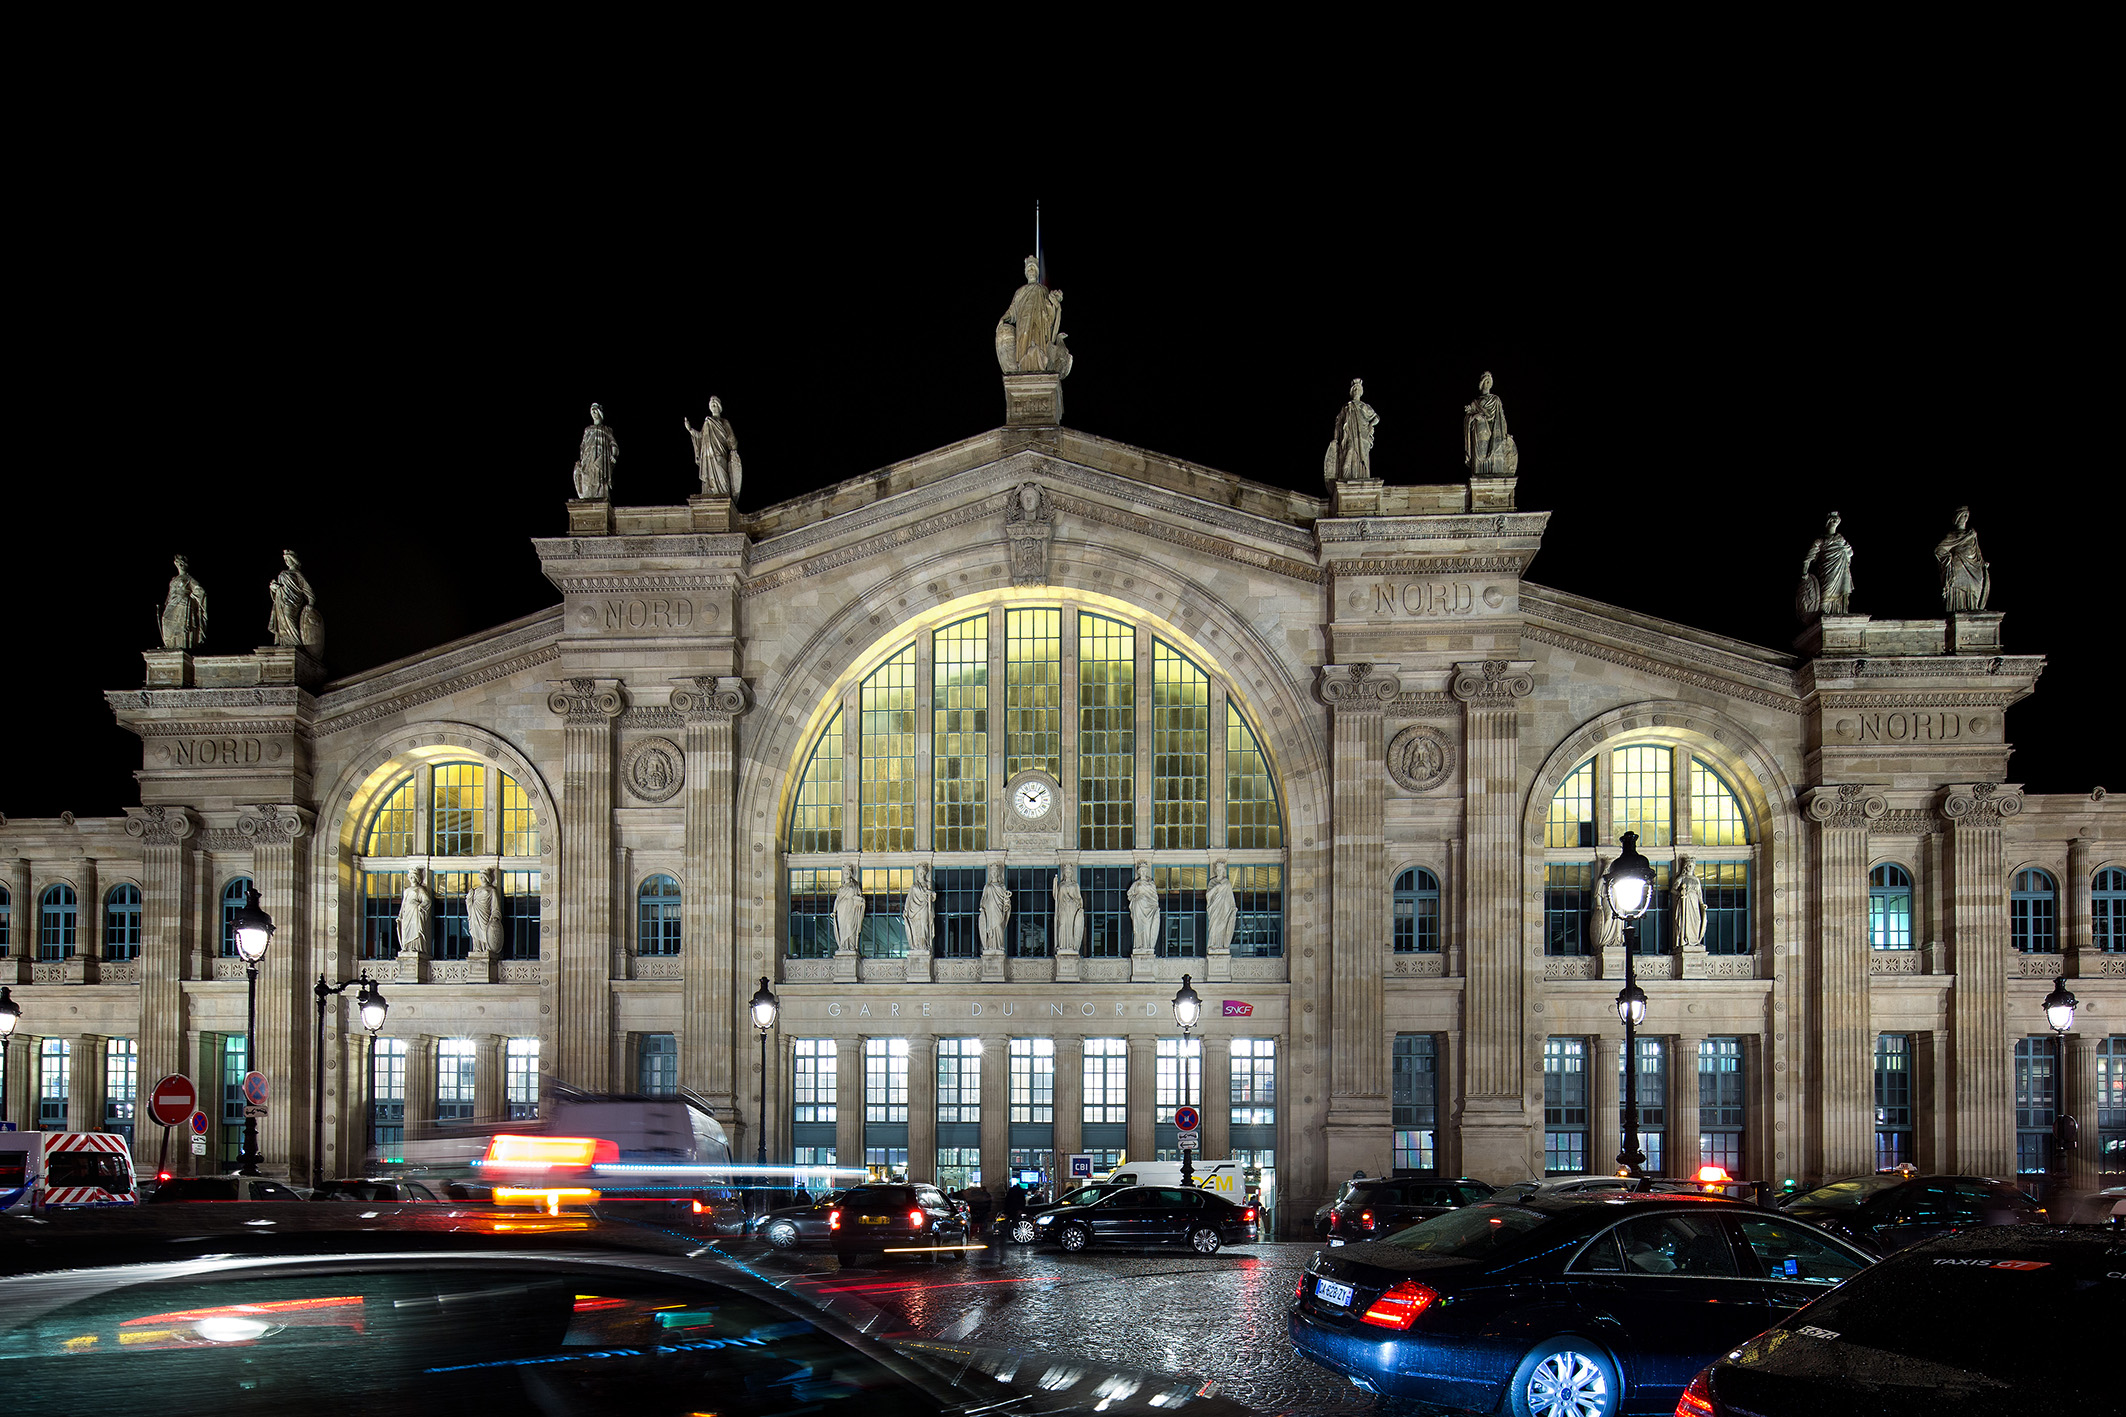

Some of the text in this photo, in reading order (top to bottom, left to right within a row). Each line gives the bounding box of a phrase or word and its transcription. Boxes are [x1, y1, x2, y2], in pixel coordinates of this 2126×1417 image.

[1374, 582, 1473, 615] NORD
[603, 598, 693, 630] NORD
[1858, 712, 1960, 741] NORD
[175, 738, 261, 766] NORD
[827, 1002, 1157, 1017] GARE DU NORD
[1224, 1005, 1253, 1015] SNCF
[1932, 1258, 2030, 1269] TAXIS G7
